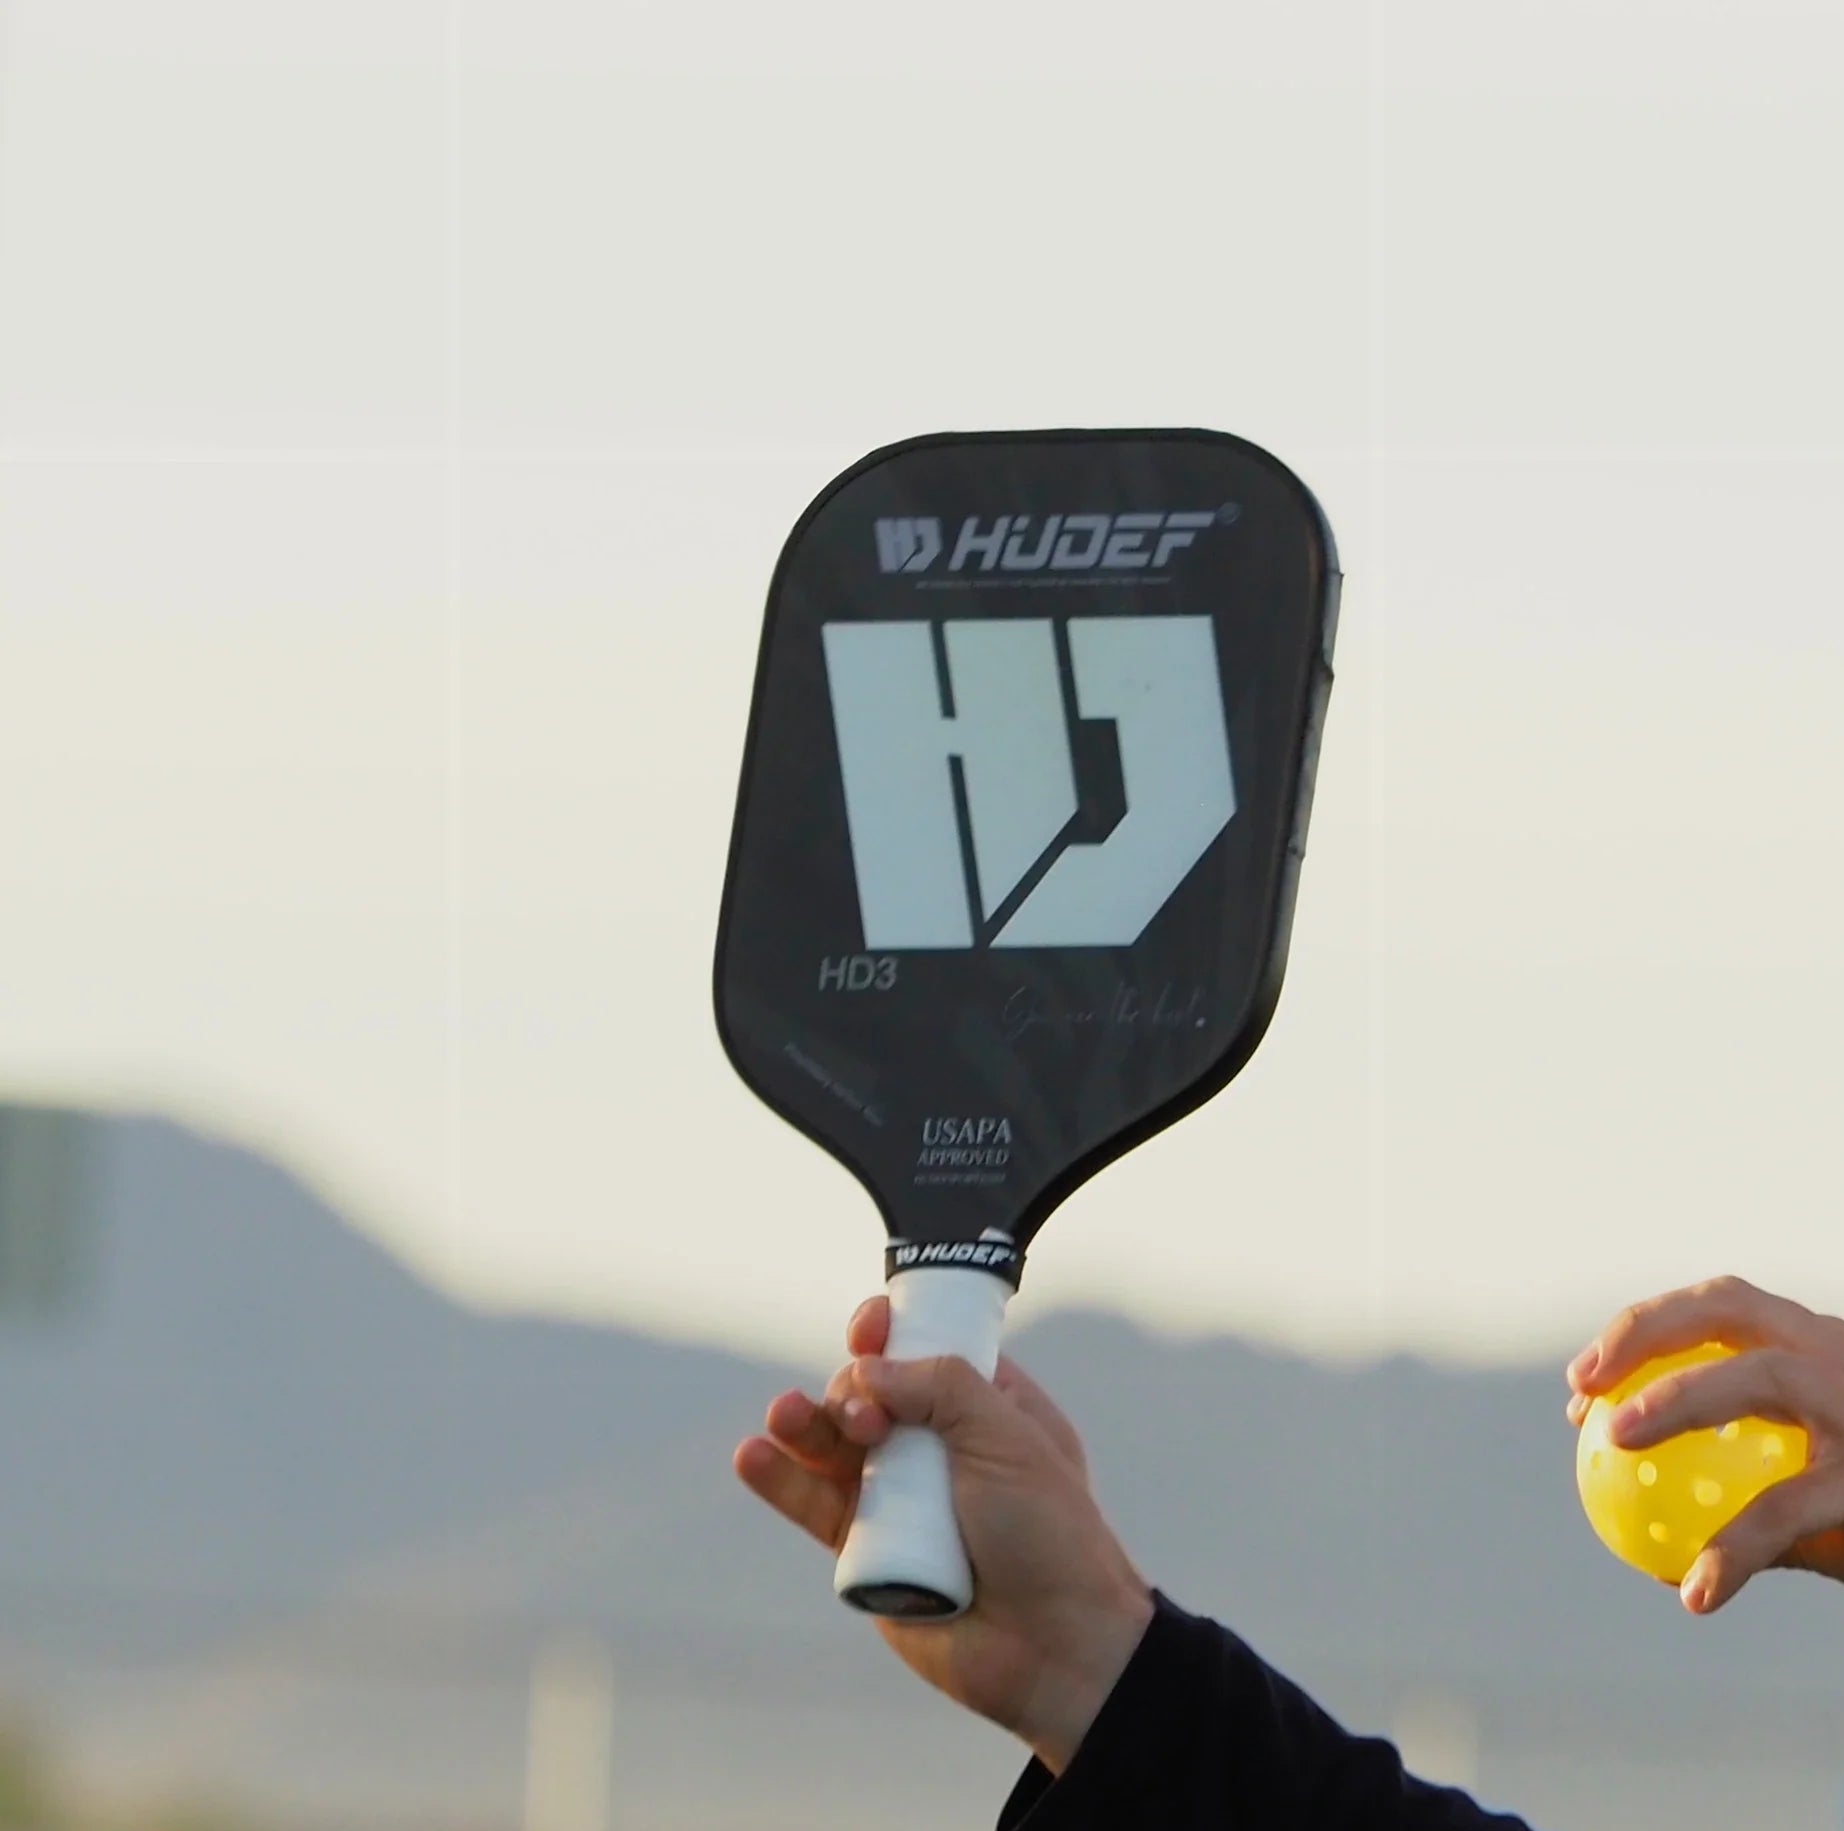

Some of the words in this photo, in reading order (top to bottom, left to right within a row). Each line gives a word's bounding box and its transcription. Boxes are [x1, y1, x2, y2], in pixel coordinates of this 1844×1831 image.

[818, 957, 898, 991] HD3
[922, 1117, 1012, 1146] USAPA
[916, 1148, 1010, 1167] APPROVED
